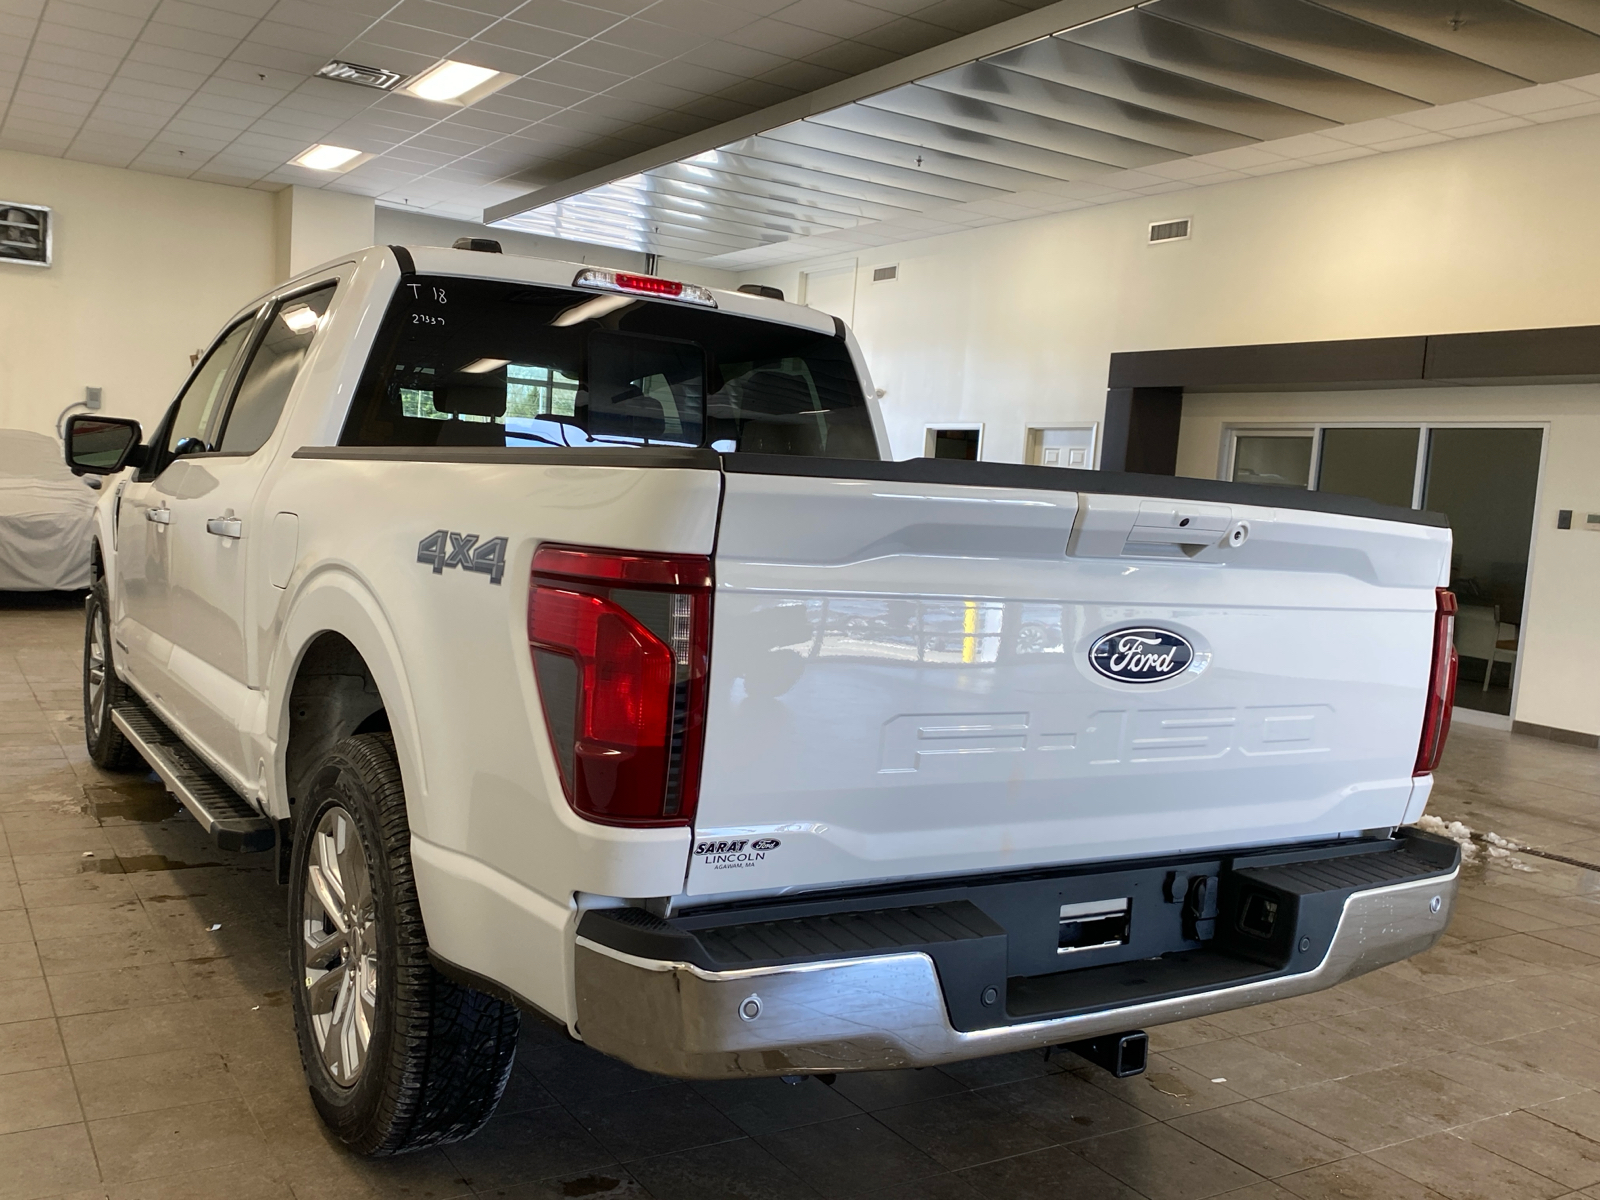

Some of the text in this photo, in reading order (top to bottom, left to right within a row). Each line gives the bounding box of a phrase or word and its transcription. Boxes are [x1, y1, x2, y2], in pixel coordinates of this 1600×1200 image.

[406, 283, 447, 304] T 18
[1109, 635, 1178, 673] Ford
[694, 839, 778, 855] SARAT Ford
[705, 852, 766, 864] LINCOLN
